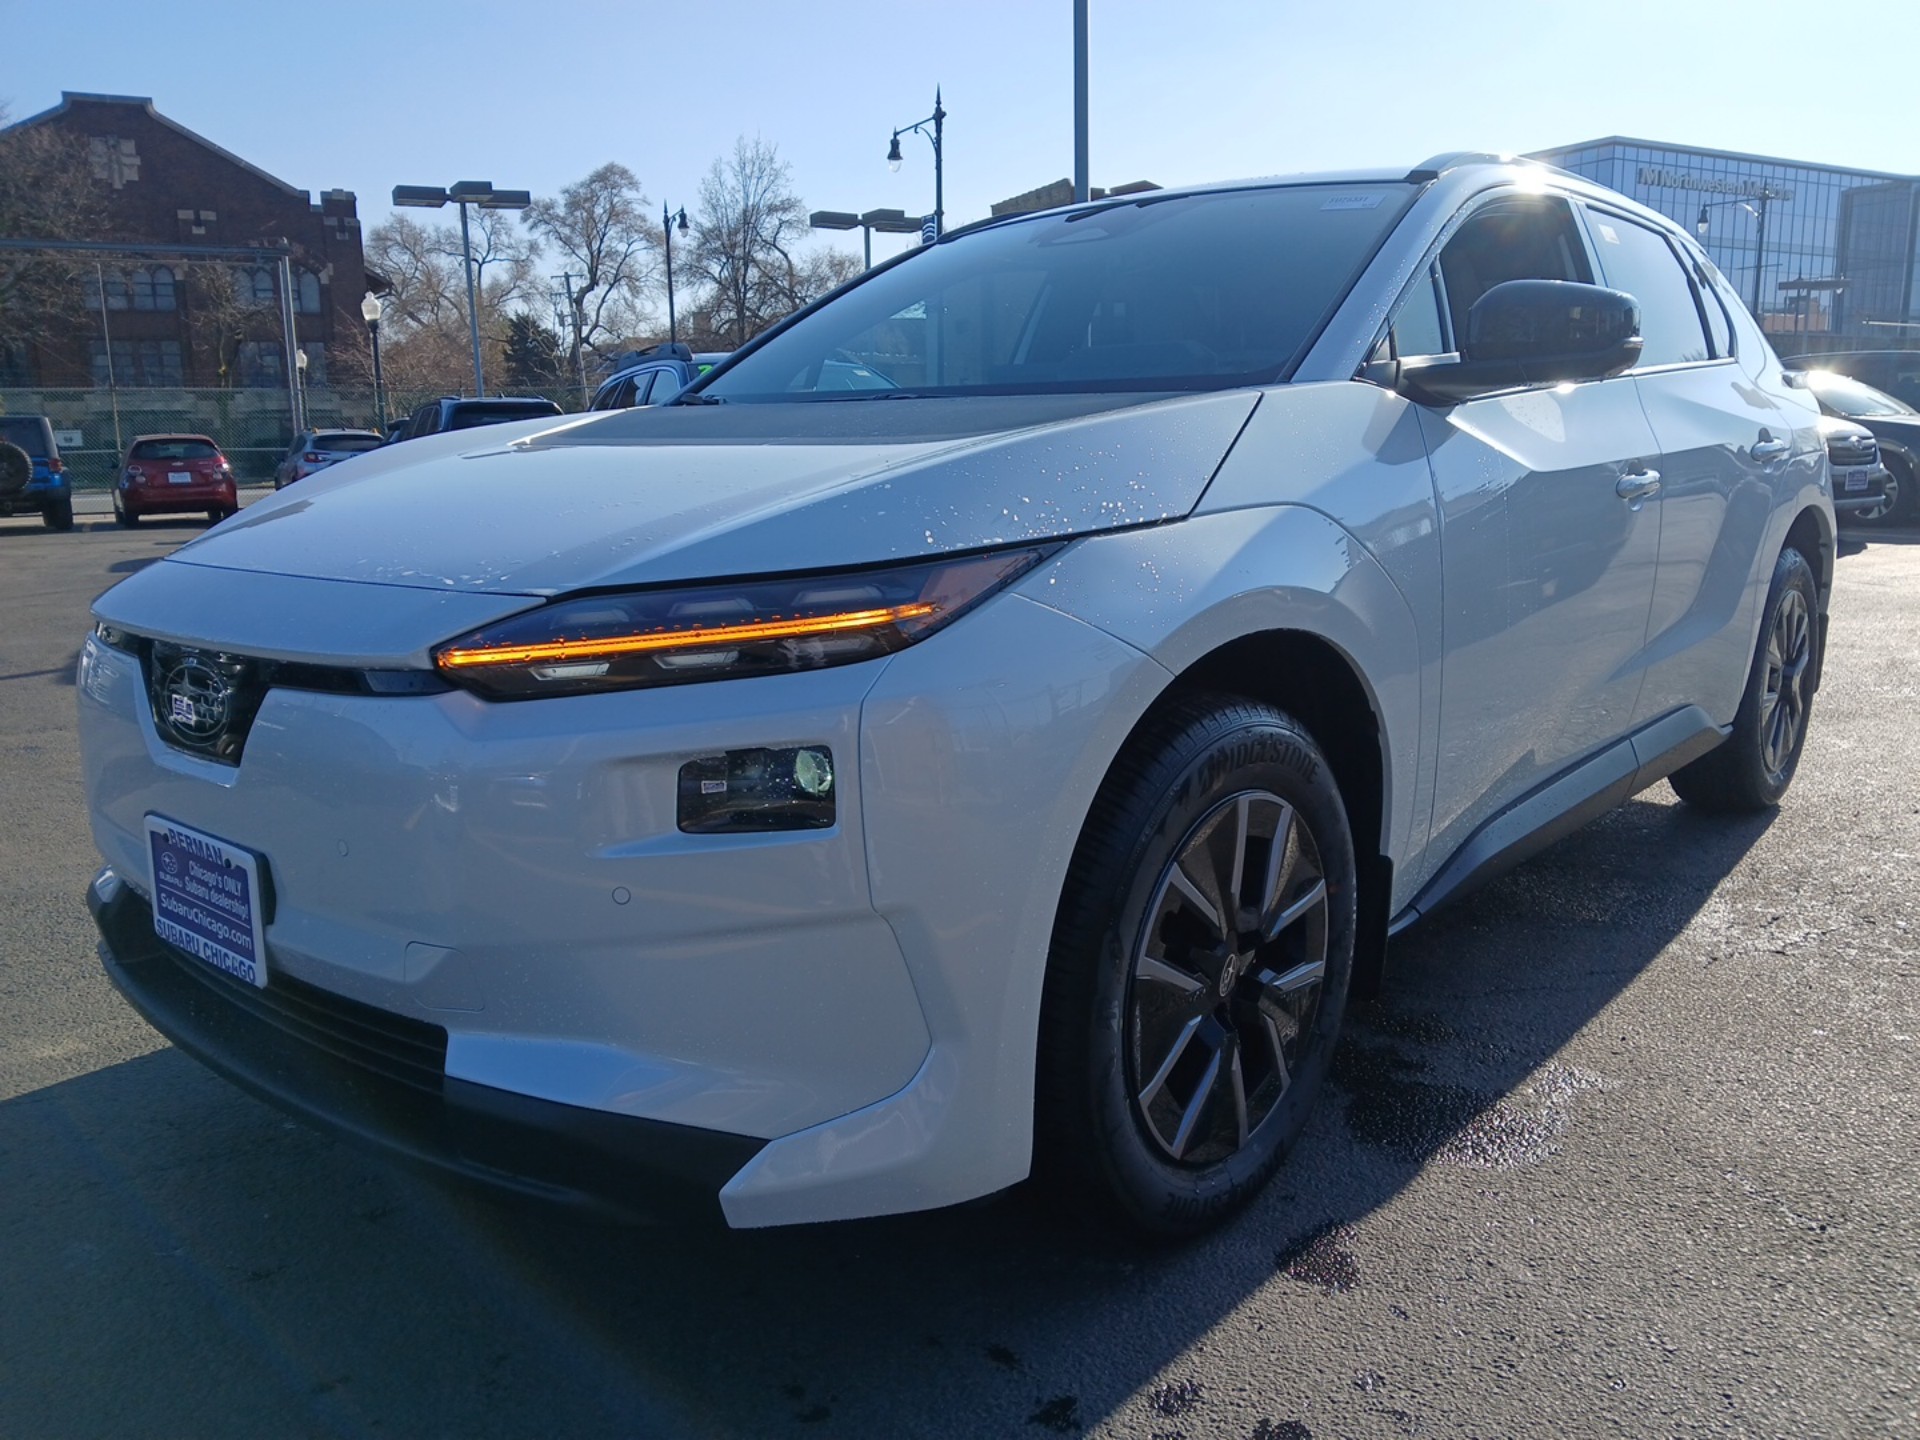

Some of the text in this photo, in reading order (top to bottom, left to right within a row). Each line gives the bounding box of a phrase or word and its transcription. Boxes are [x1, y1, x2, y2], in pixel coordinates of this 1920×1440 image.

[1660, 169, 1745, 194] Northwestern
[168, 828, 224, 866] BERMAN
[184, 876, 249, 920] Subaru dealership!
[189, 860, 242, 897] Chicago's ONLY
[160, 893, 252, 950] SubaruChicago.com
[156, 918, 256, 984] SUBARU CHICAGO
